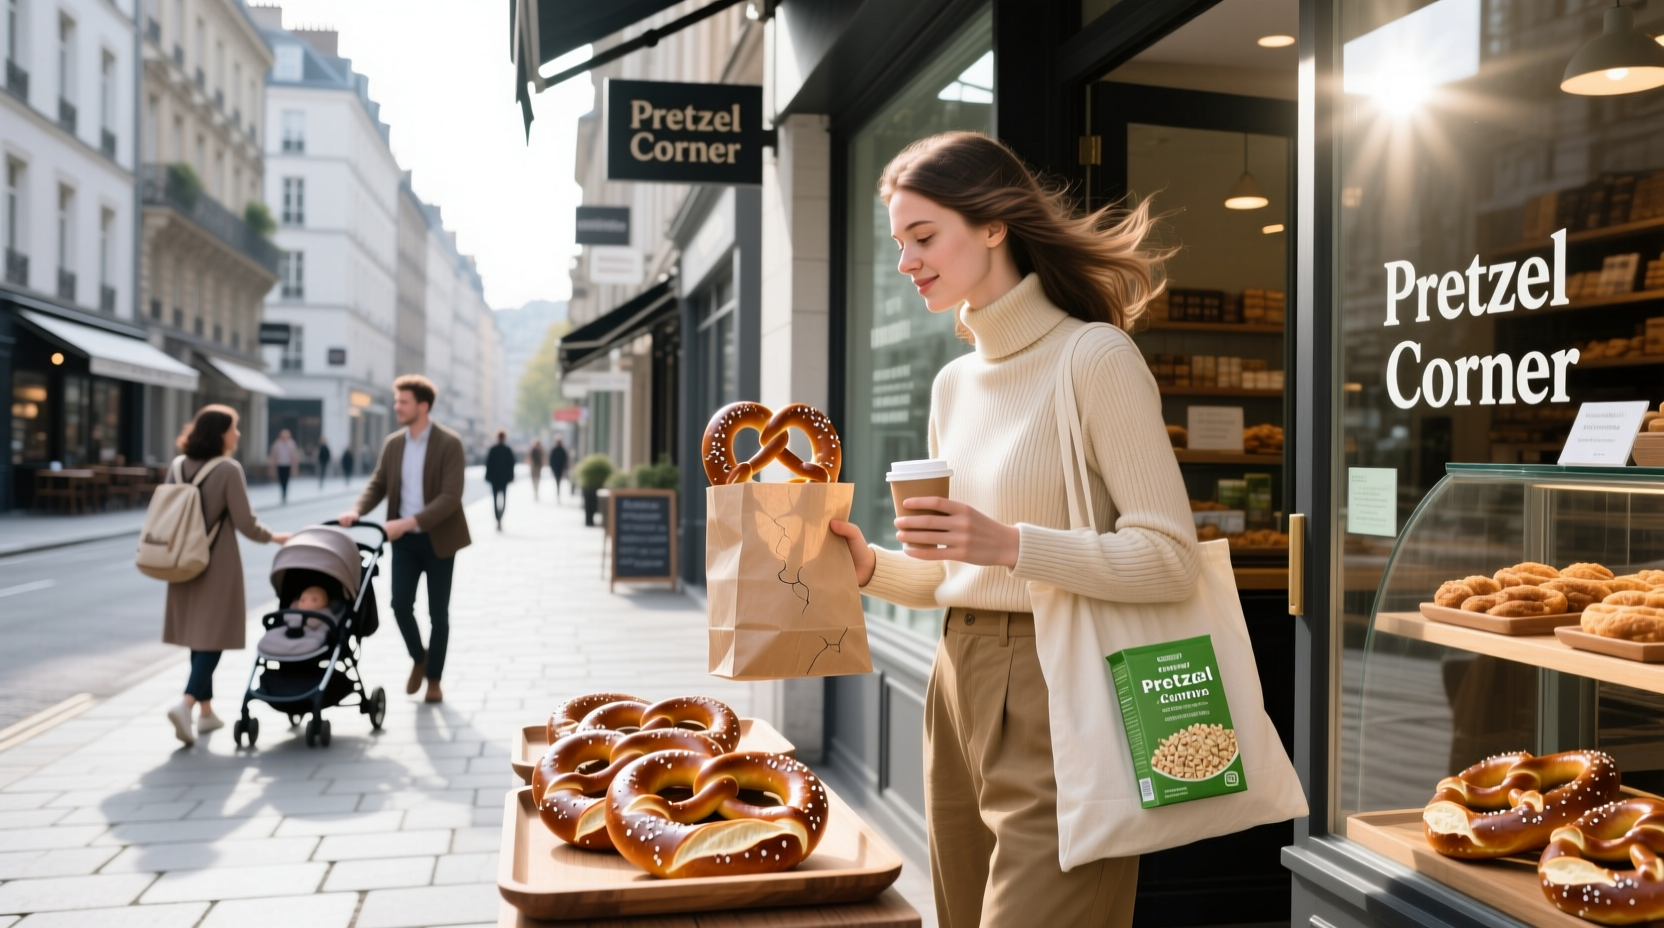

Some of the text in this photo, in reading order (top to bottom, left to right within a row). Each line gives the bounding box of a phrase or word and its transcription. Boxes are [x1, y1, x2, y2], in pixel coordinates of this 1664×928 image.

[629, 99, 742, 132] Pretzel
[629, 132, 742, 164] Corner
[1383, 228, 1570, 327] Pretzel
[1386, 340, 1581, 410] Corner
